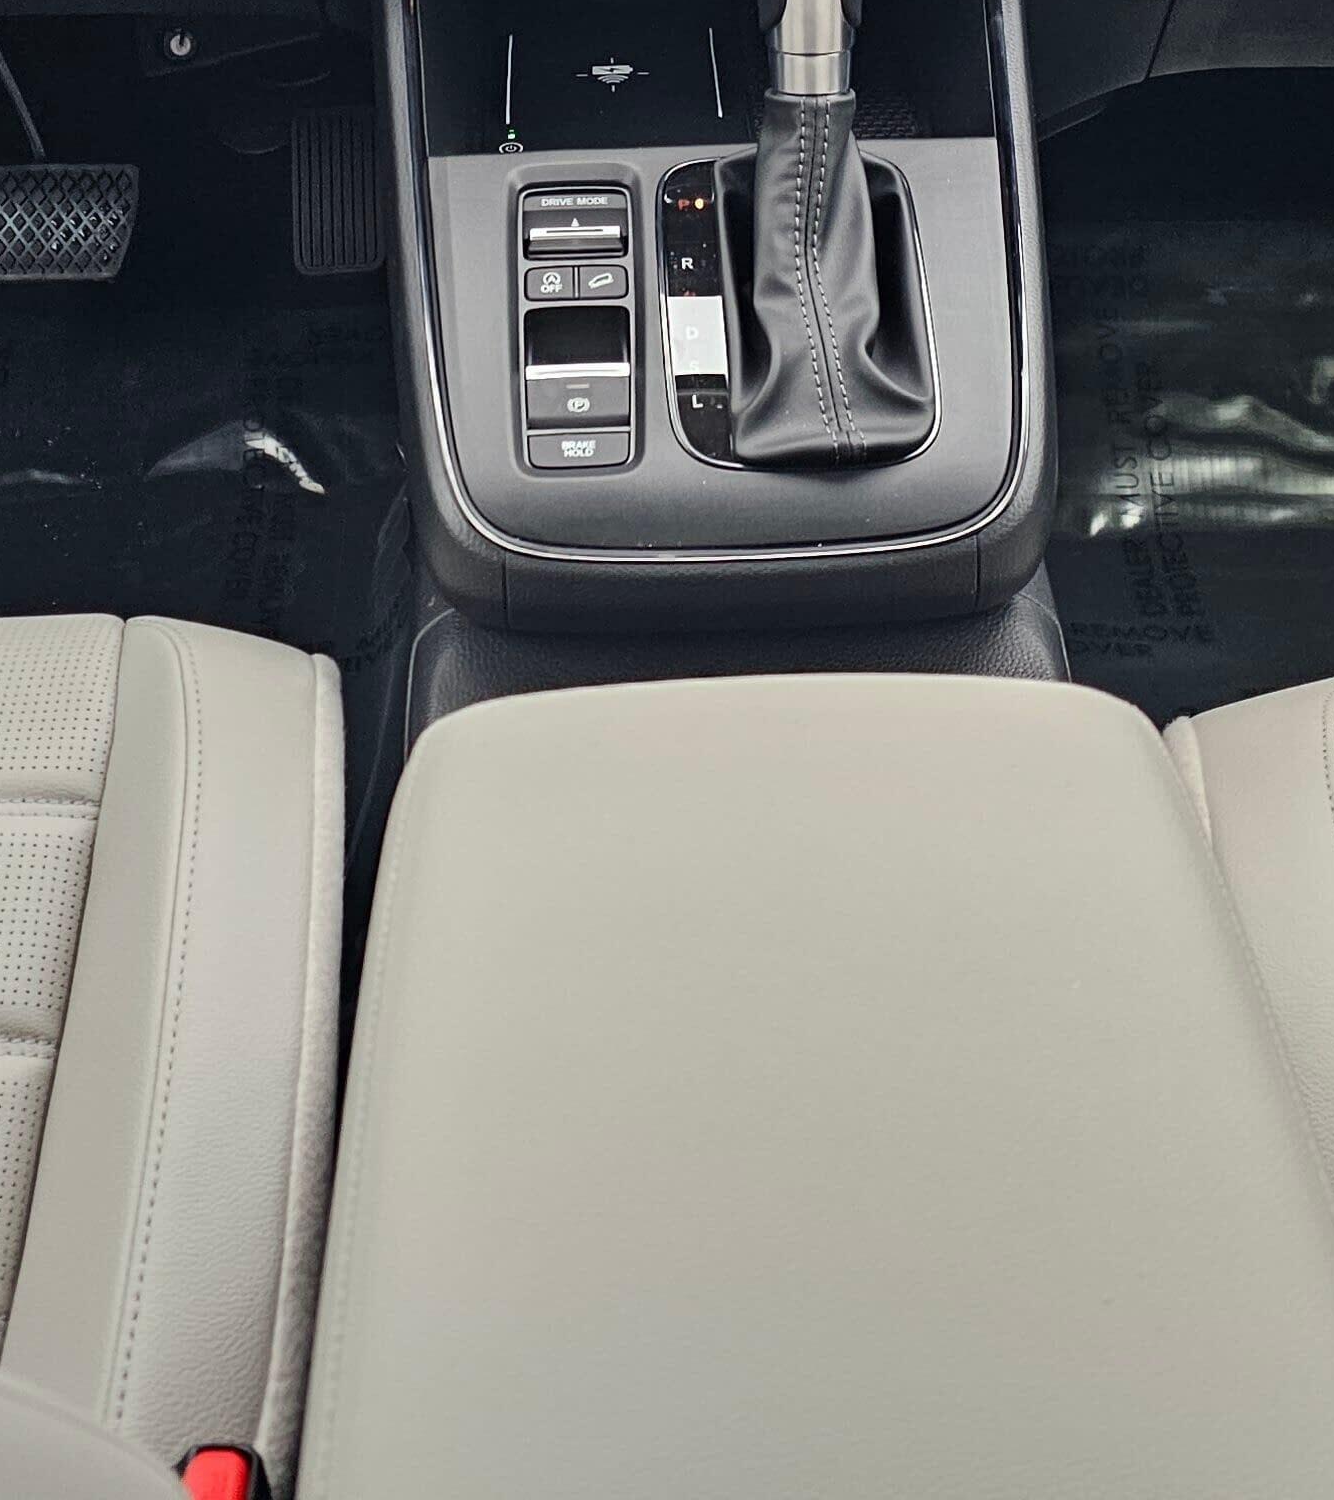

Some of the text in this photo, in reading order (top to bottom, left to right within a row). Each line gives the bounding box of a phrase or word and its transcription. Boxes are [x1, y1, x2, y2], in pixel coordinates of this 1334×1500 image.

[541, 196, 608, 207] DRIVE MODE
[678, 199, 690, 210] P
[681, 257, 694, 270] R
[540, 284, 563, 293] OFF
[686, 326, 699, 339] D
[691, 395, 704, 408] L
[561, 440, 596, 450] BRAKE
[563, 449, 594, 457] HOLD
